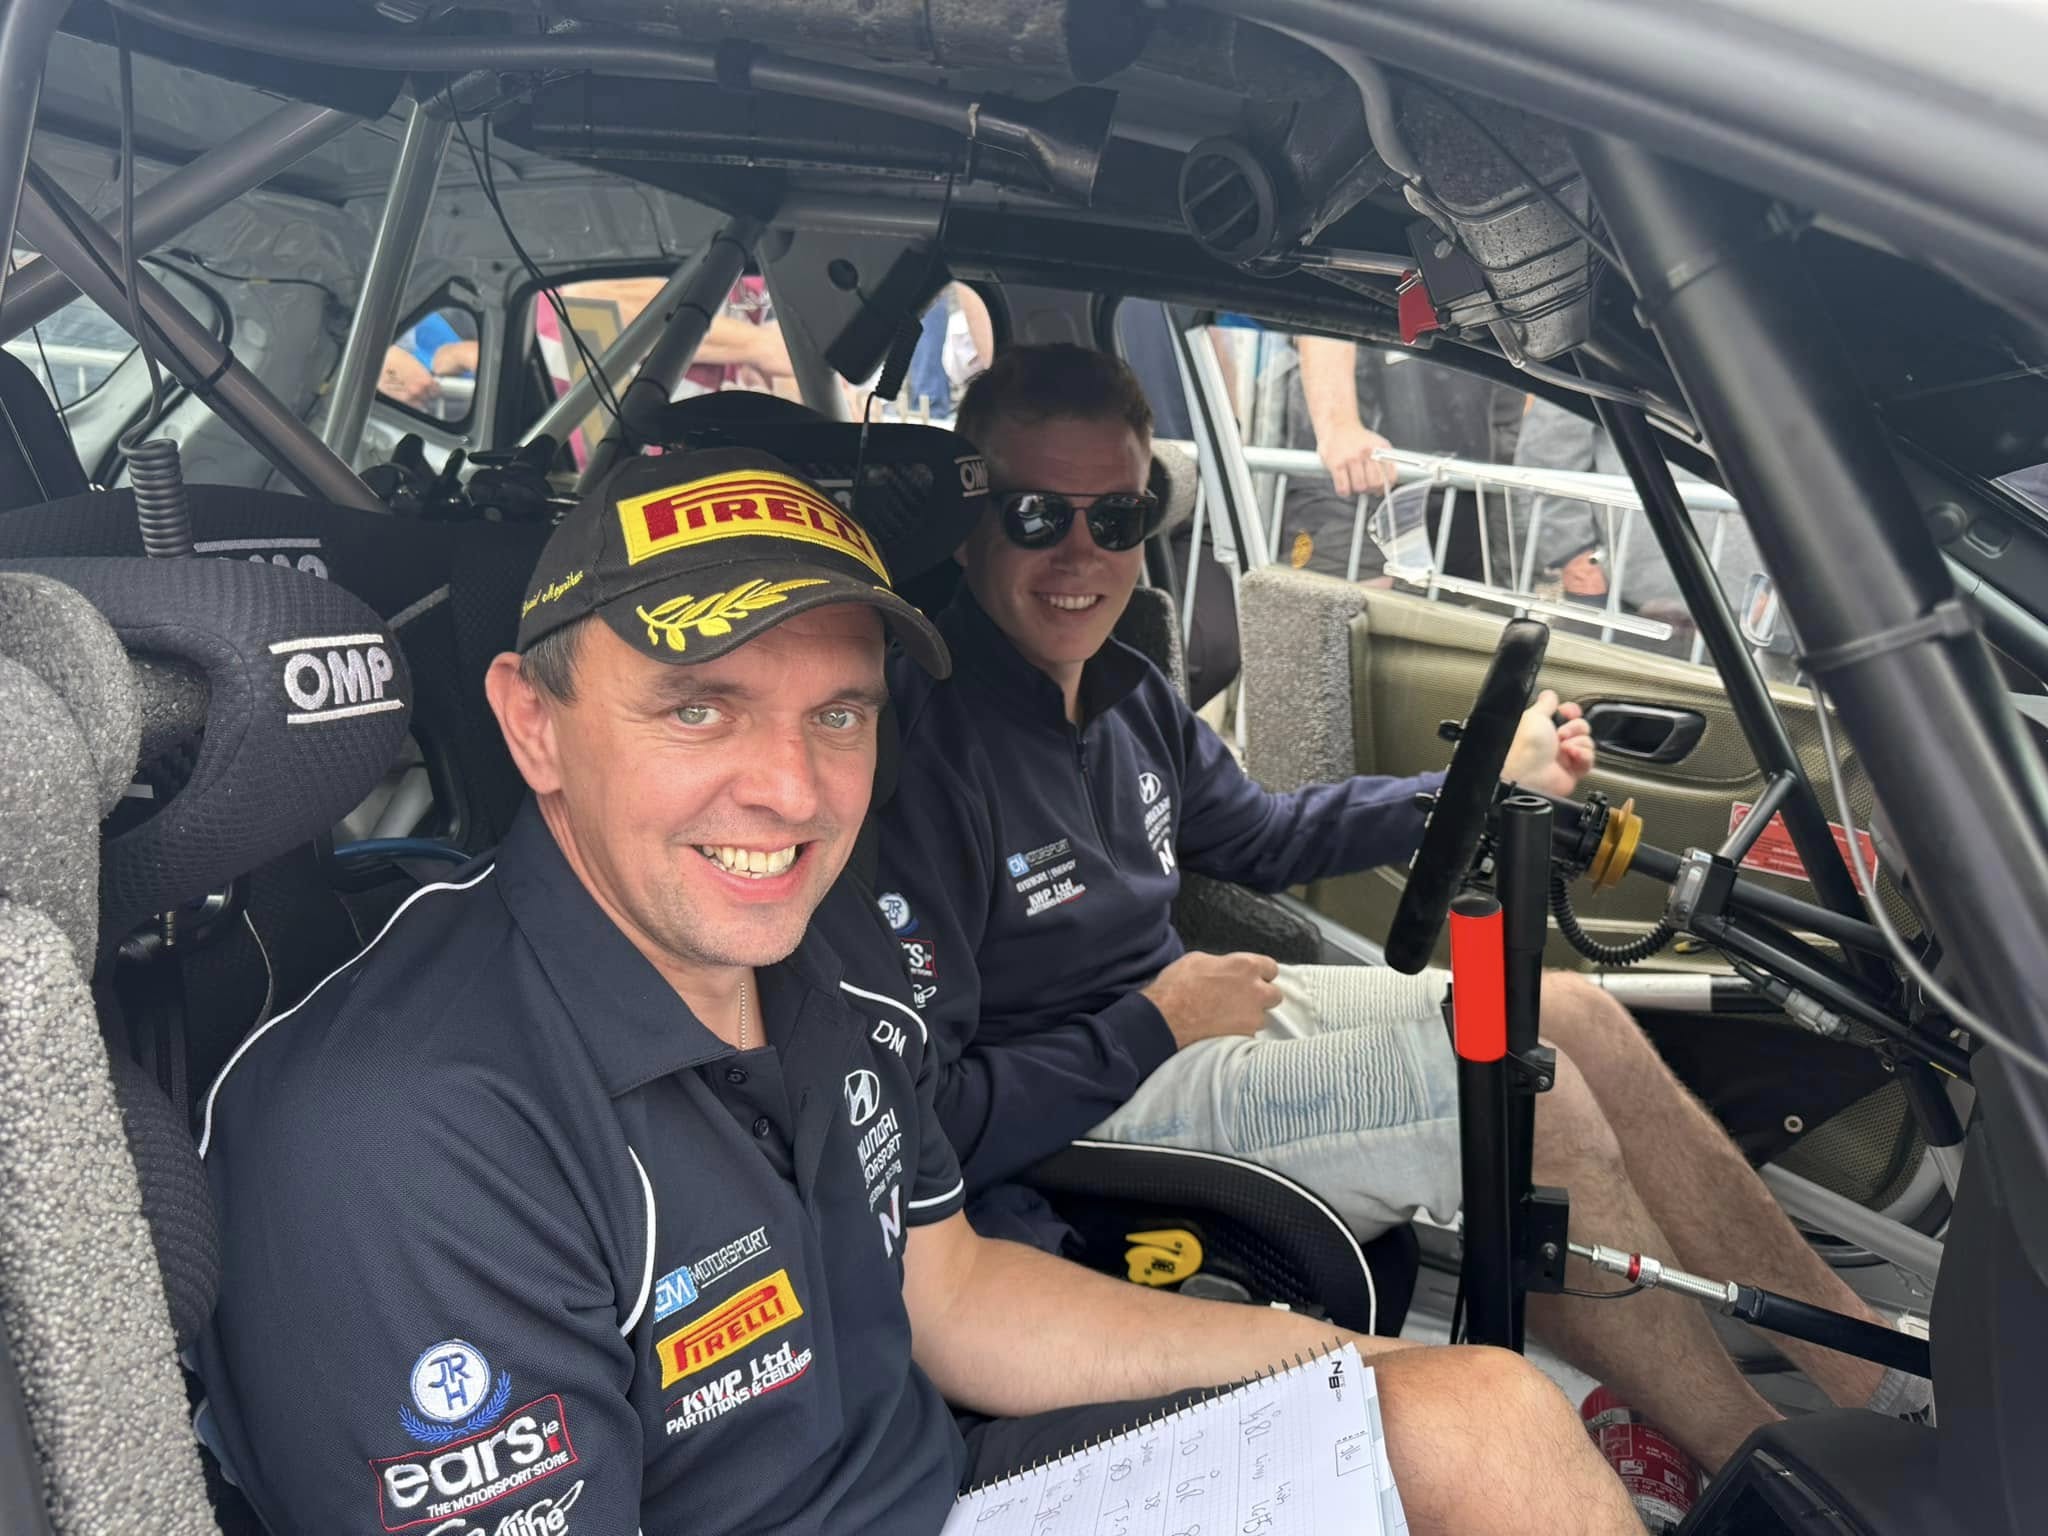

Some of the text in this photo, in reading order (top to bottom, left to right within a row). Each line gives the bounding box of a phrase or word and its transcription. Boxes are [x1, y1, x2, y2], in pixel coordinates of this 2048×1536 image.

[283, 646, 394, 711] OMP
[871, 1019, 908, 1058] DM
[688, 1225, 770, 1286] MOTORSPORT
[673, 1284, 787, 1373] PIRELLI
[665, 1348, 813, 1436] PARTITIONS & CEILINGS
[682, 1368, 743, 1417] KWP
[426, 1450, 569, 1519] THE MOTORSPORT STORE
